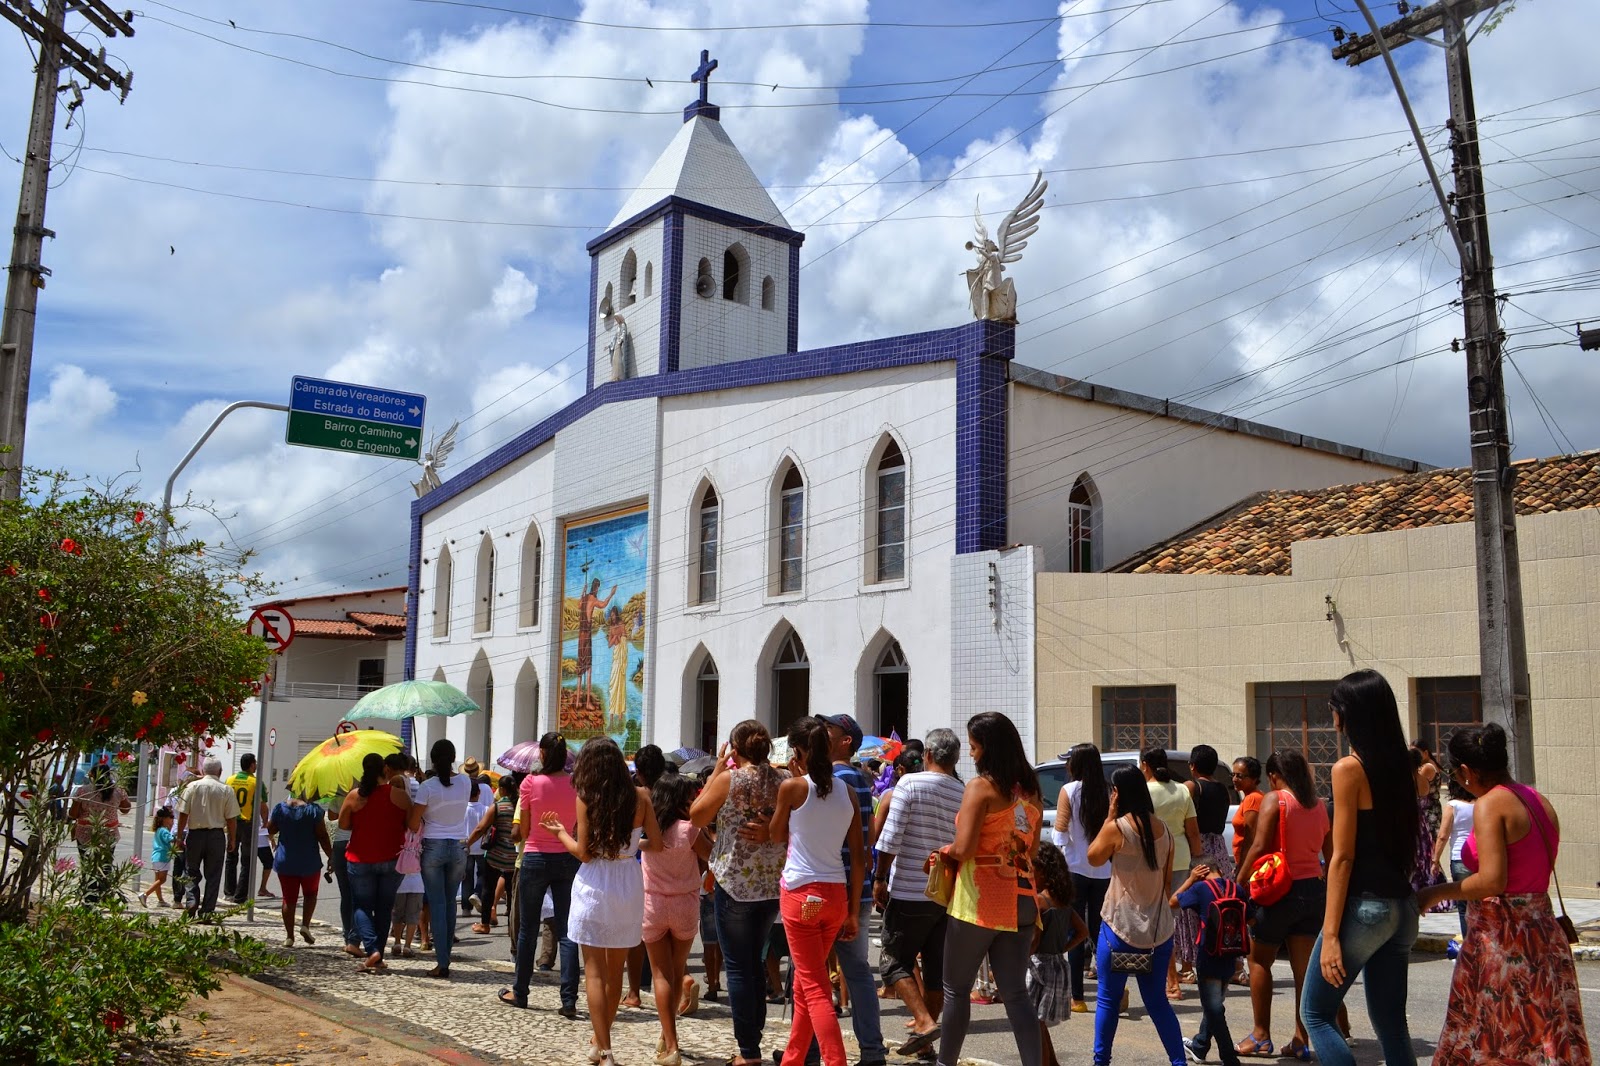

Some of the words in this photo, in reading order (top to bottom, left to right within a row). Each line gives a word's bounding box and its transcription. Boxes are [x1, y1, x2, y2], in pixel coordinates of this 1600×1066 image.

[294, 381, 334, 395] Câmara
[336, 387, 349, 398] de
[350, 389, 406, 407] Vereadores
[314, 399, 354, 414] Estrada
[357, 406, 370, 416] do
[373, 408, 405, 421] Bendó
[324, 420, 356, 433] Bairro
[359, 425, 403, 439] Caminho
[340, 438, 354, 448] do
[357, 439, 401, 454] Engenho
